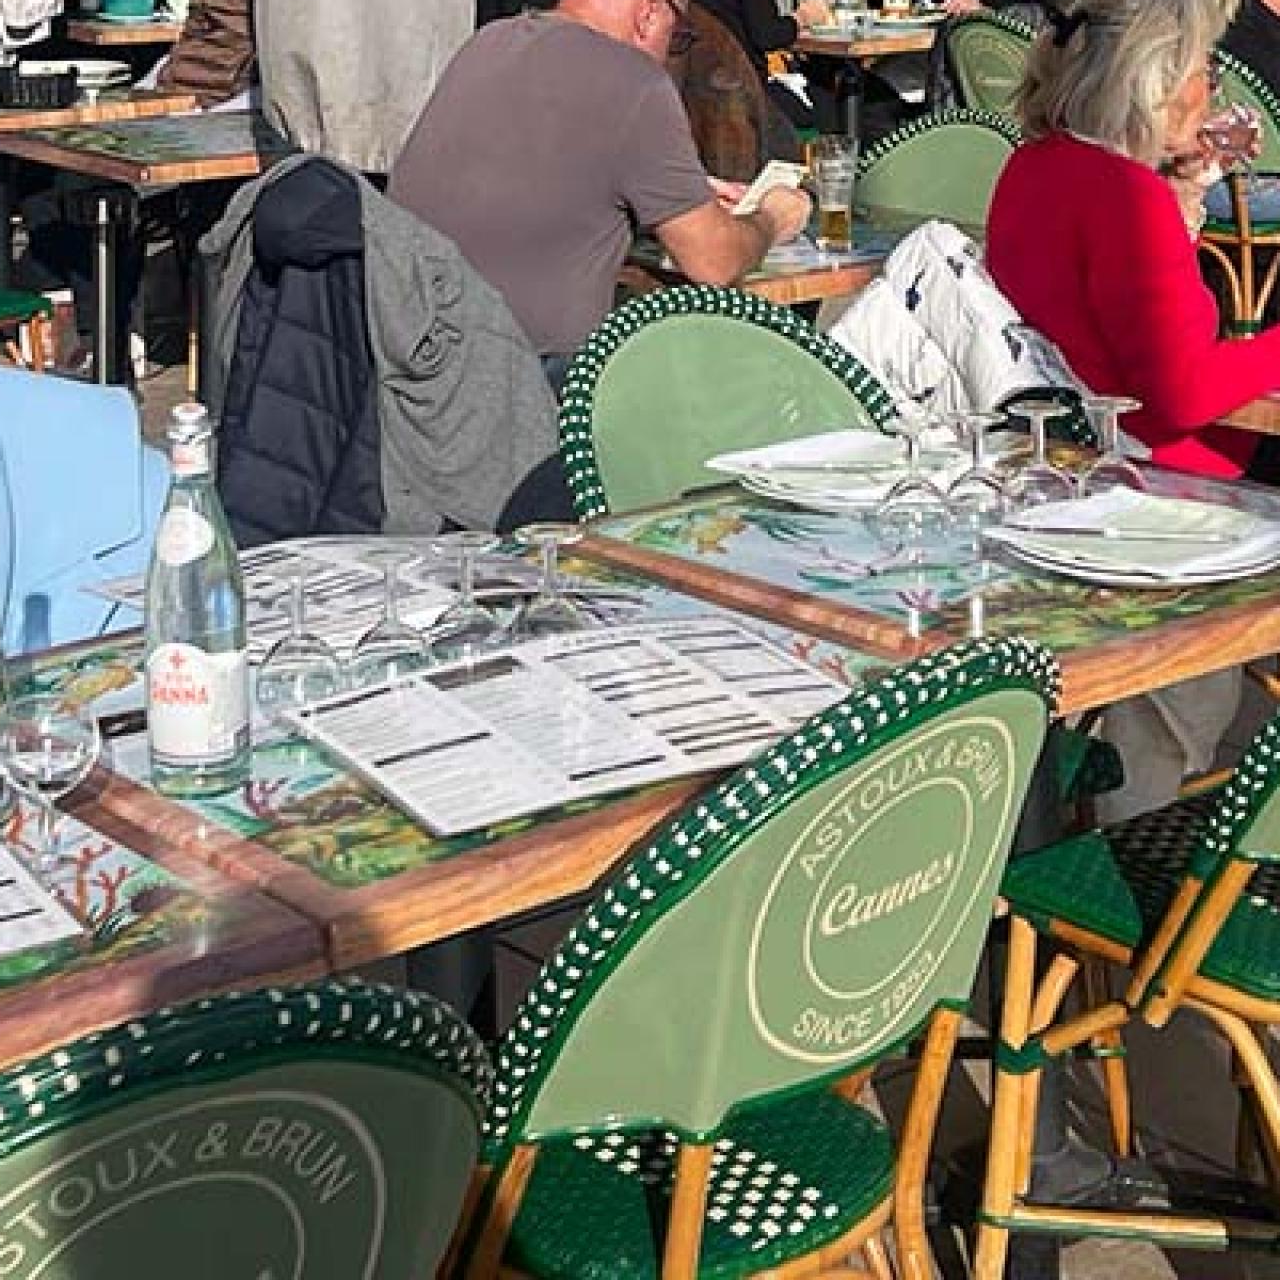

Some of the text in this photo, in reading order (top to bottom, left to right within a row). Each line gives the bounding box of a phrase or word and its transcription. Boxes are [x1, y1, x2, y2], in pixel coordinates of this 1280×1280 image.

[800, 748, 936, 879] ASTOUX
[819, 849, 956, 937] Cannes
[792, 1001, 875, 1046] SINCE
[194, 1121, 232, 1162] &
[242, 1115, 360, 1205] BRUN
